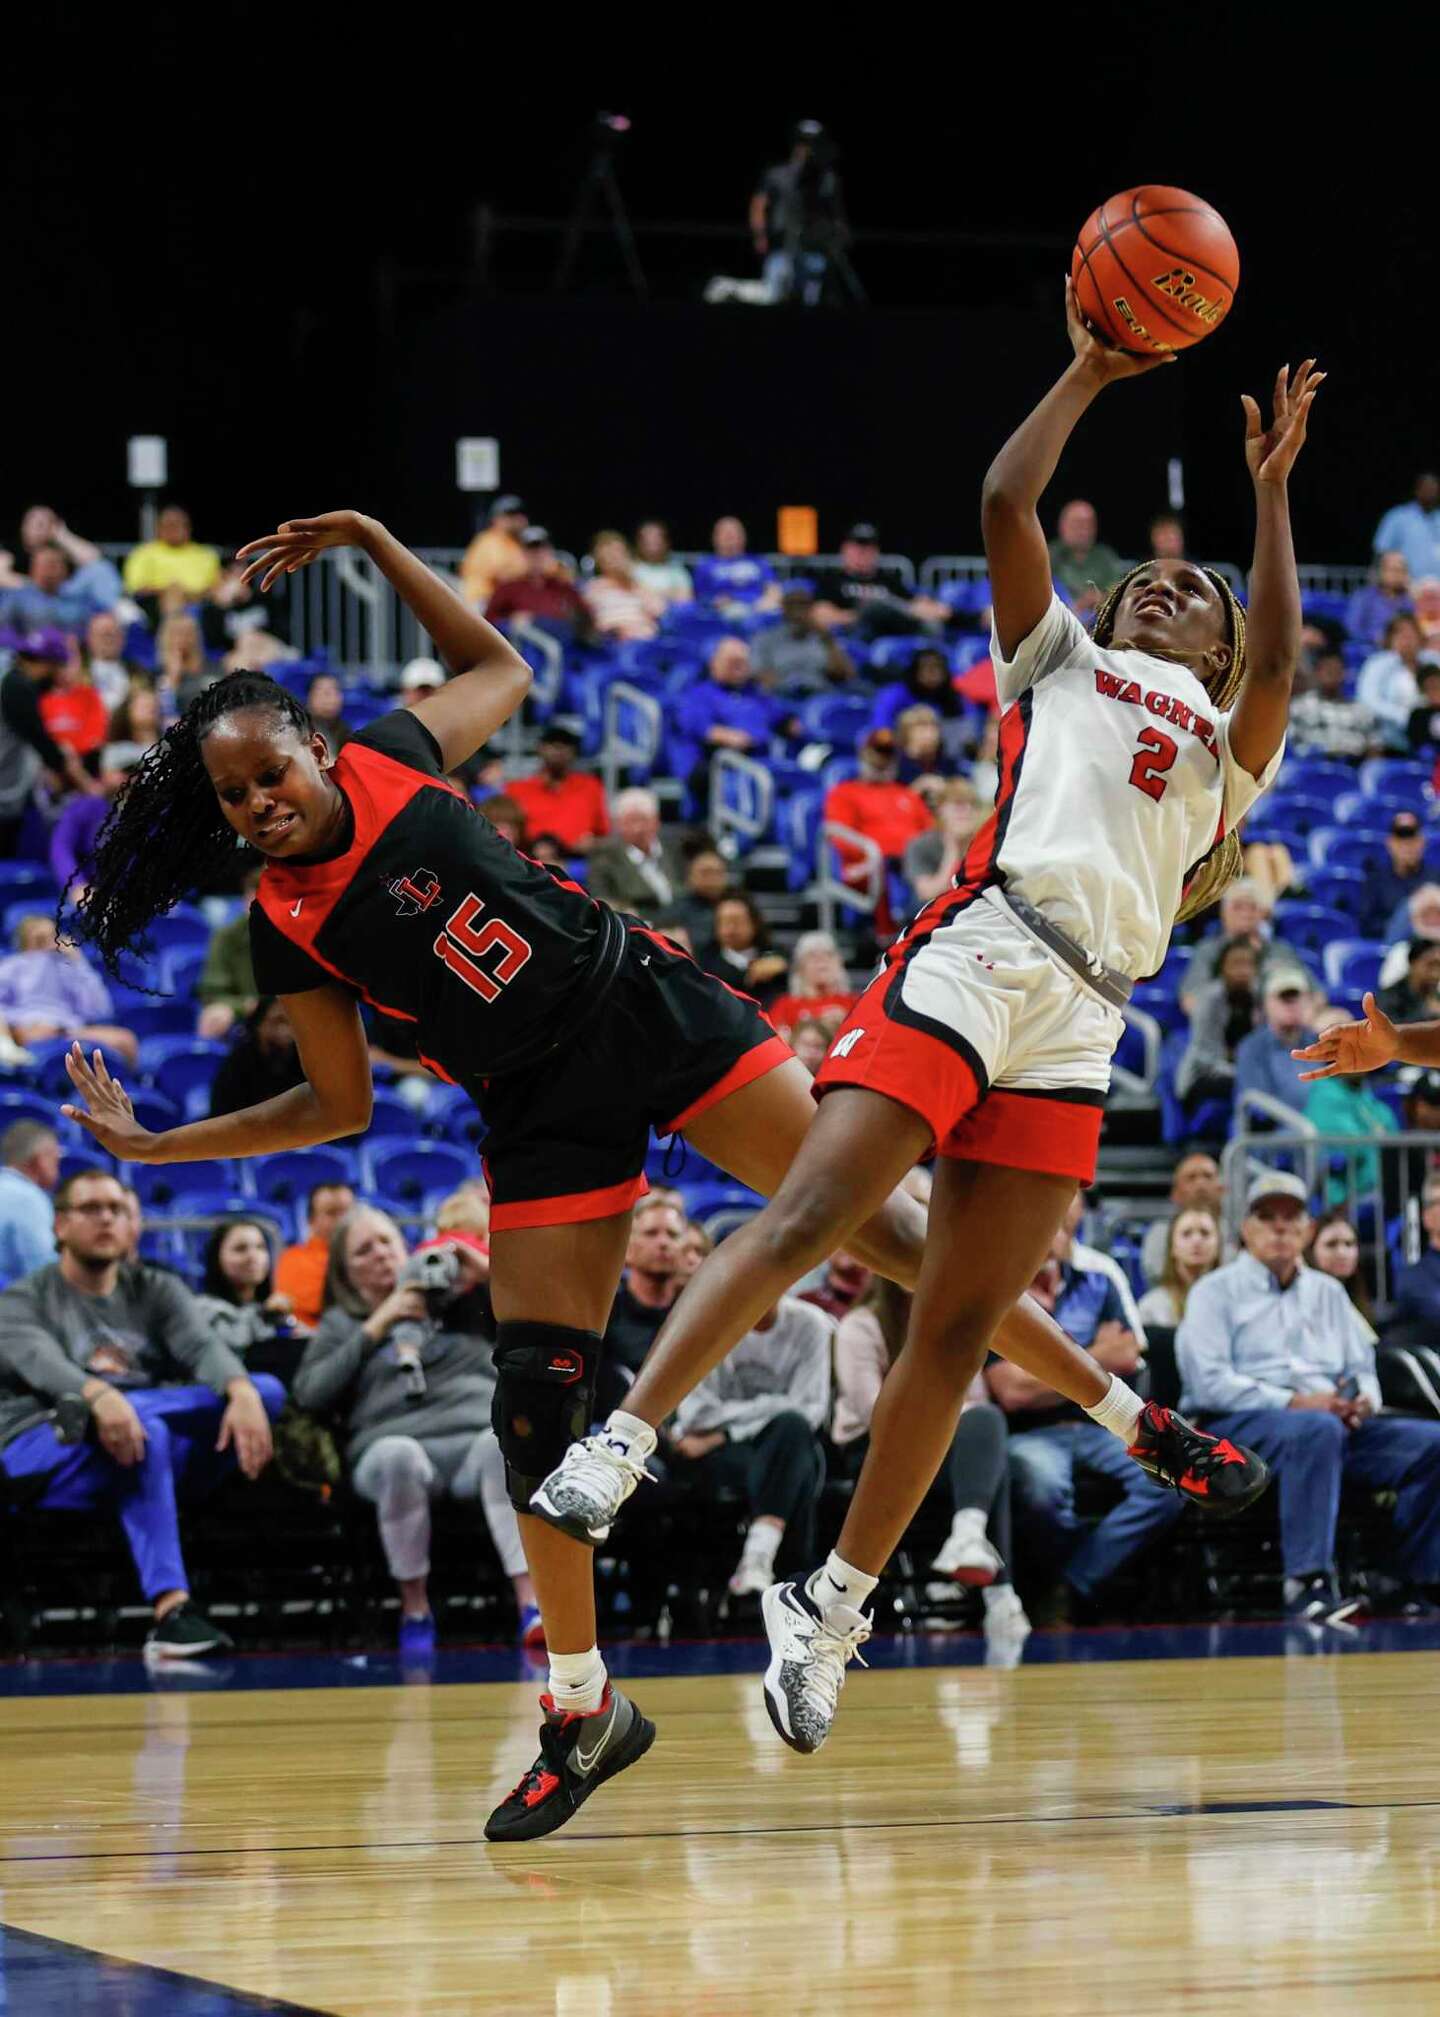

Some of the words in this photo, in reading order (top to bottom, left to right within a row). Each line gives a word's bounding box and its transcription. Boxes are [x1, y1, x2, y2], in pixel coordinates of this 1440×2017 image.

[1094, 669, 1220, 764] WAGNE
[1129, 726, 1179, 803] 2
[433, 892, 532, 1004] 15
